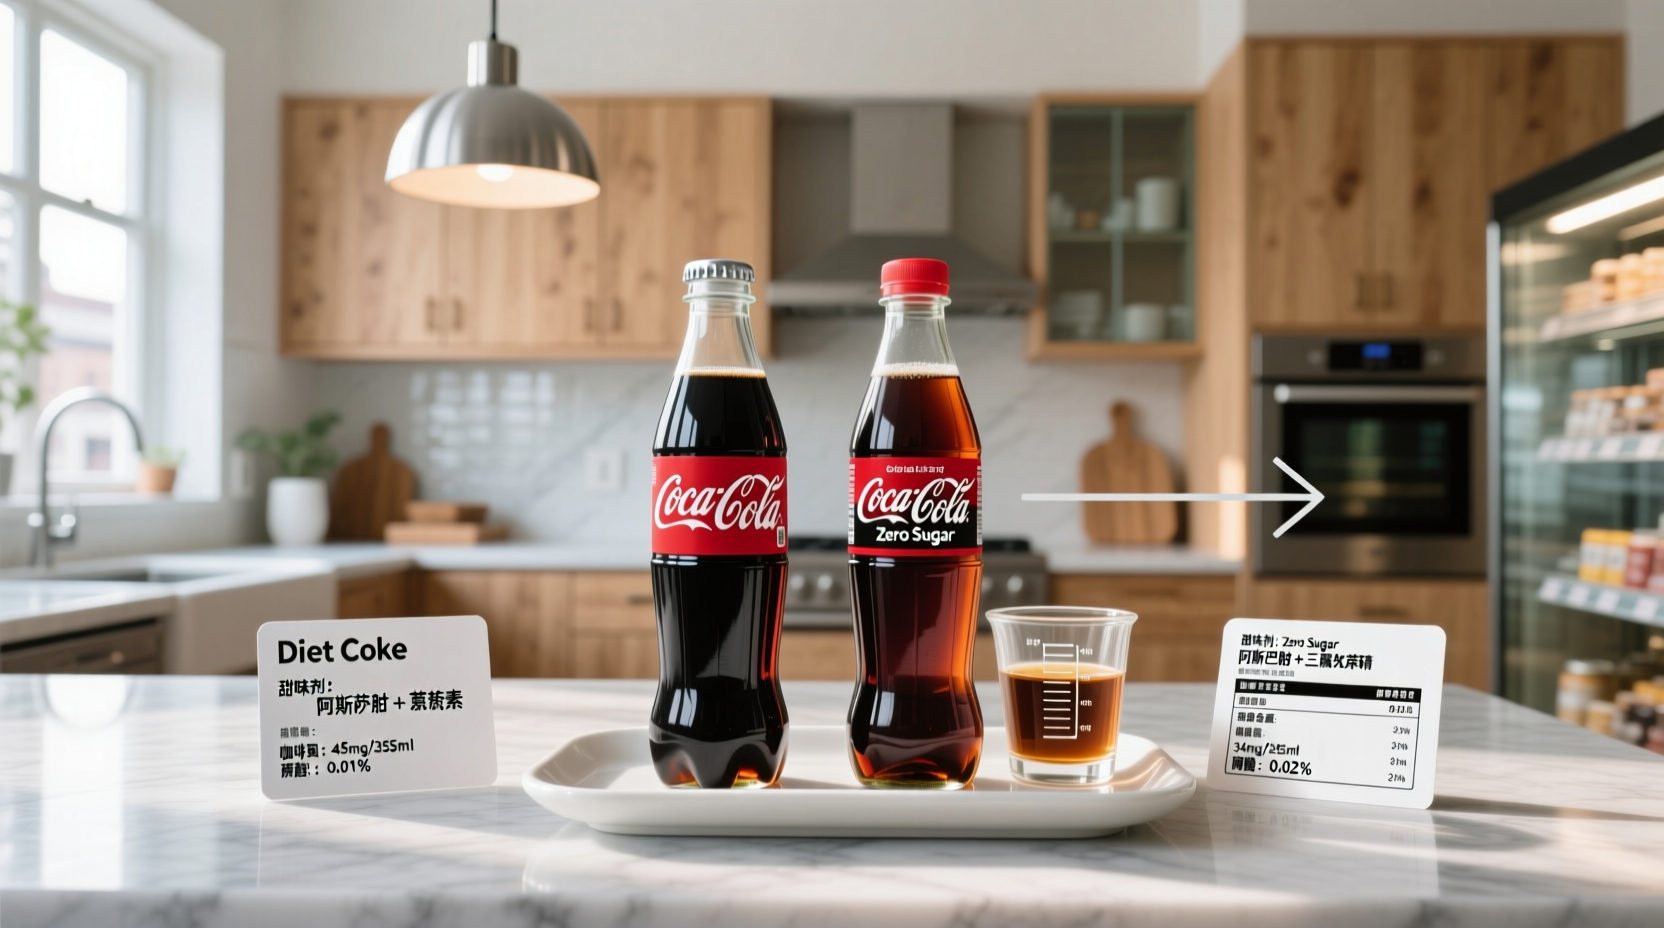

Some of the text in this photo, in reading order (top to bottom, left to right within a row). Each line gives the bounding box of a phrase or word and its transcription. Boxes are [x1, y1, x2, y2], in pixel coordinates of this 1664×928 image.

[654, 474, 785, 531] Coca-Cola
[857, 477, 976, 524] Coca-Cola
[876, 526, 955, 546] Zero Sugar
[278, 636, 408, 664] Diet Coke
[1306, 637, 1340, 652] Sugar
[327, 758, 371, 774] 0.01%
[1269, 759, 1312, 776] 0.02%
